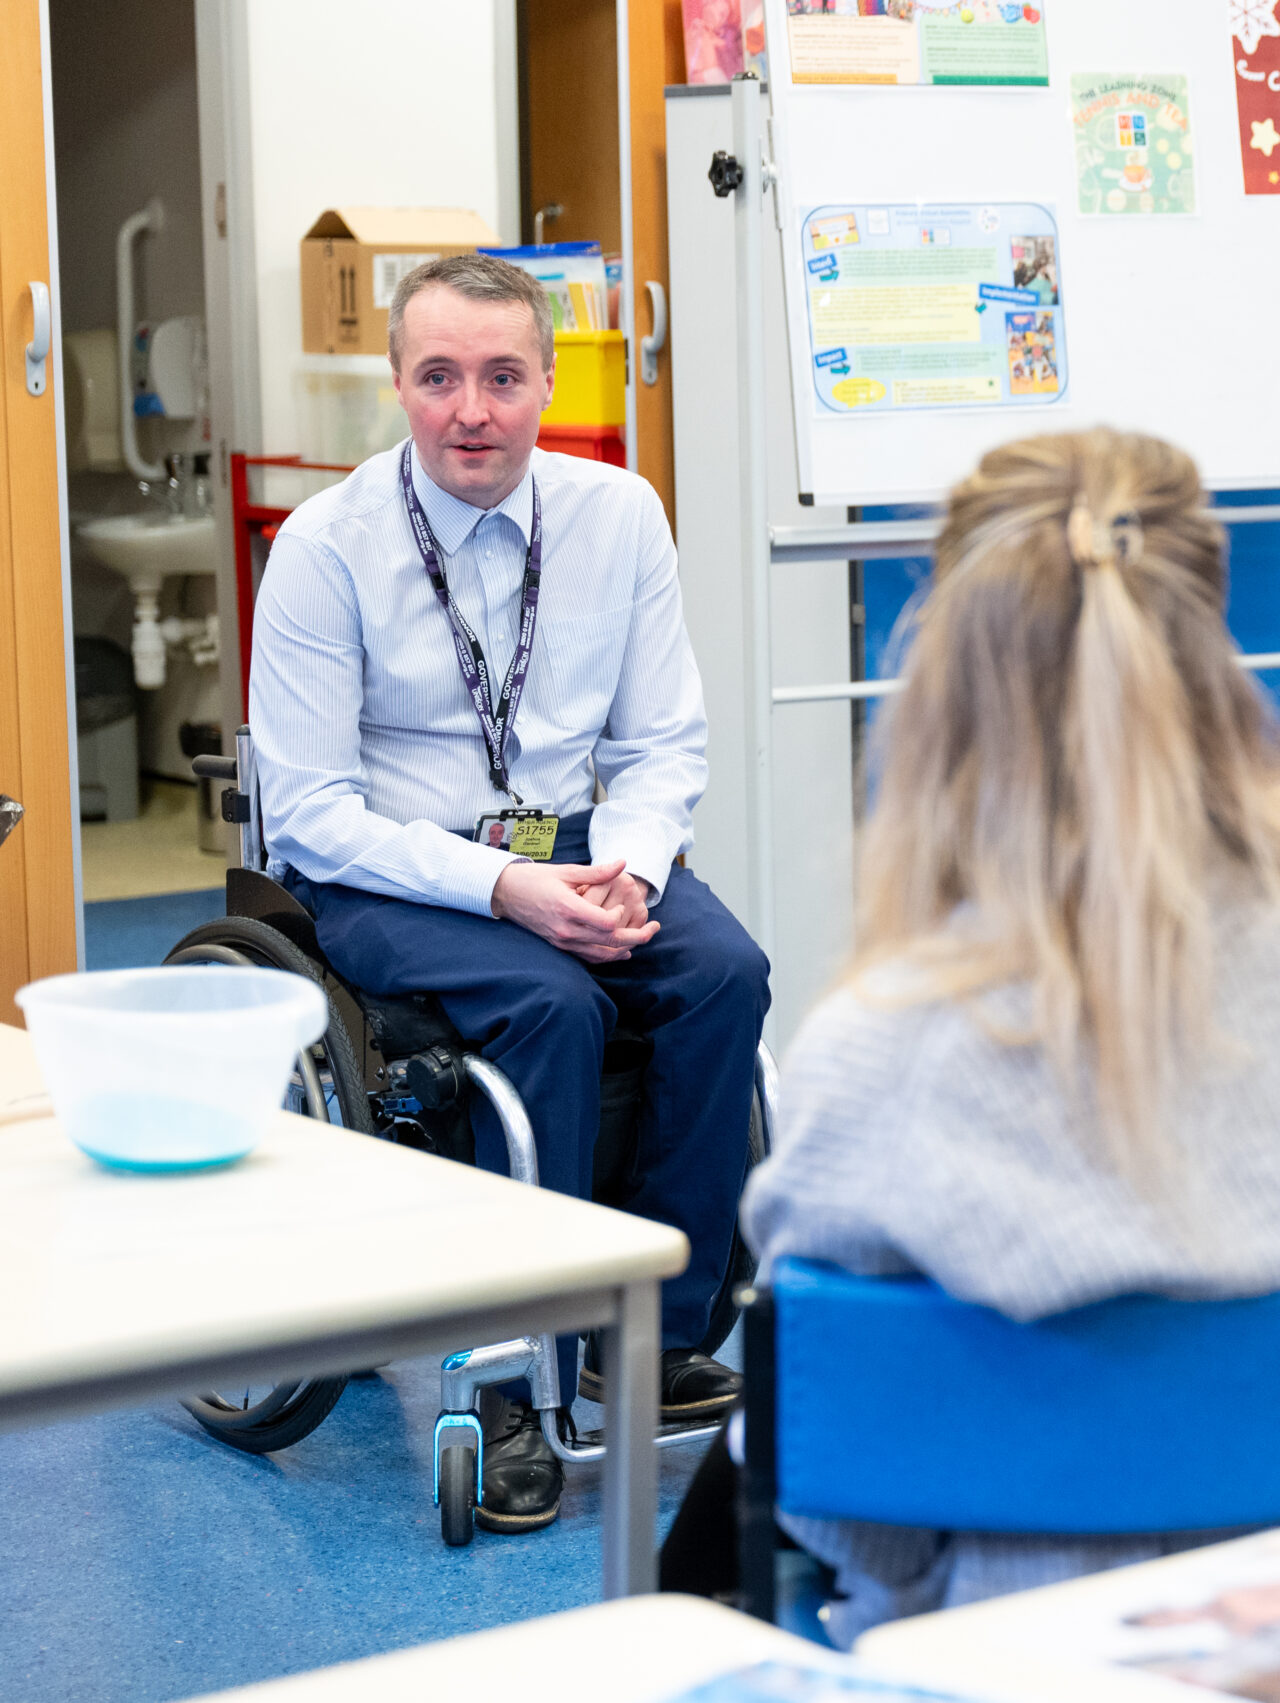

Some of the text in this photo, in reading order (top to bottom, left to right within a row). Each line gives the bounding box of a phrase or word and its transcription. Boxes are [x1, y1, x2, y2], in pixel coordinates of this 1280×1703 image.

[1073, 92, 1121, 128] TENNIS
[1126, 92, 1160, 109] AND
[1164, 101, 1188, 132] TEA
[517, 825, 554, 836] S1755
